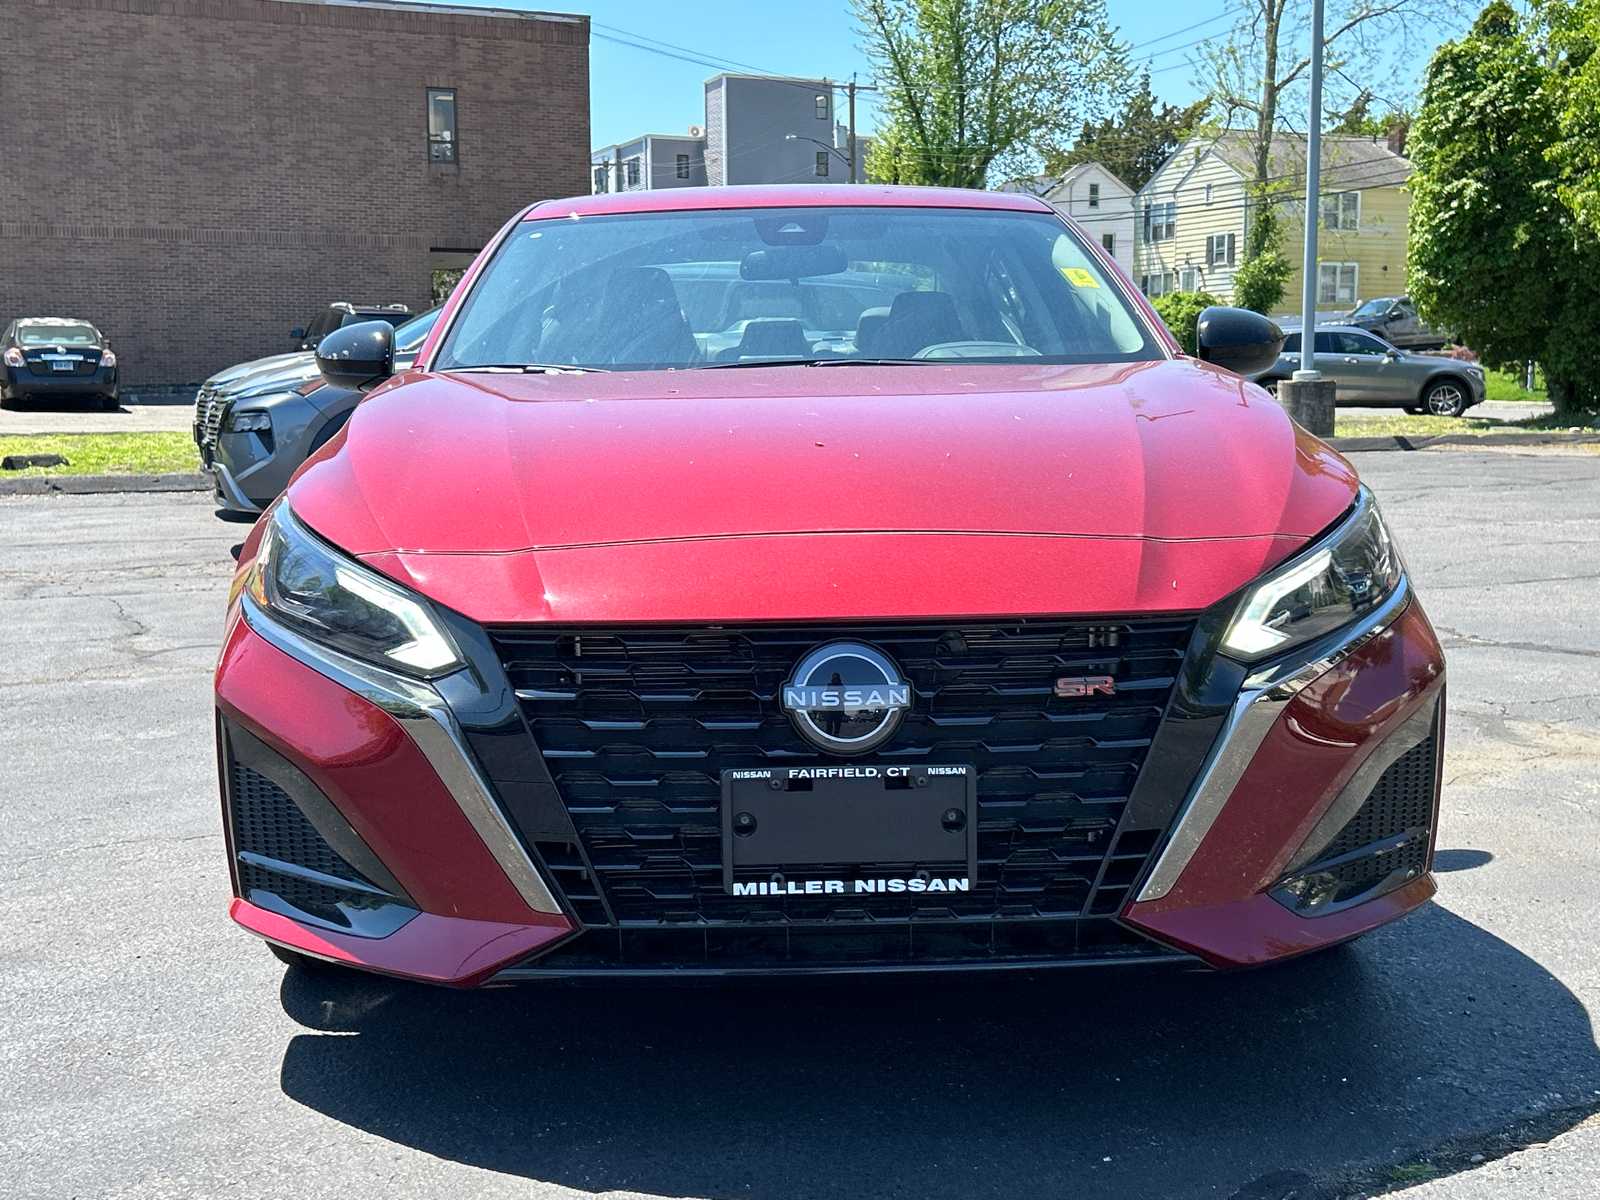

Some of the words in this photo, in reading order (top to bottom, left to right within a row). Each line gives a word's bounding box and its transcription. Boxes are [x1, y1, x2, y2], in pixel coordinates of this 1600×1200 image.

[1056, 676, 1115, 697] SR
[787, 689, 908, 706] NISSAN
[732, 770, 771, 779] NISSAN
[788, 768, 882, 779] FAIRFIELD,
[886, 767, 911, 777] CT
[927, 767, 966, 775] NISSAN
[733, 880, 844, 896] MILLER
[855, 878, 969, 893] NISSAN
